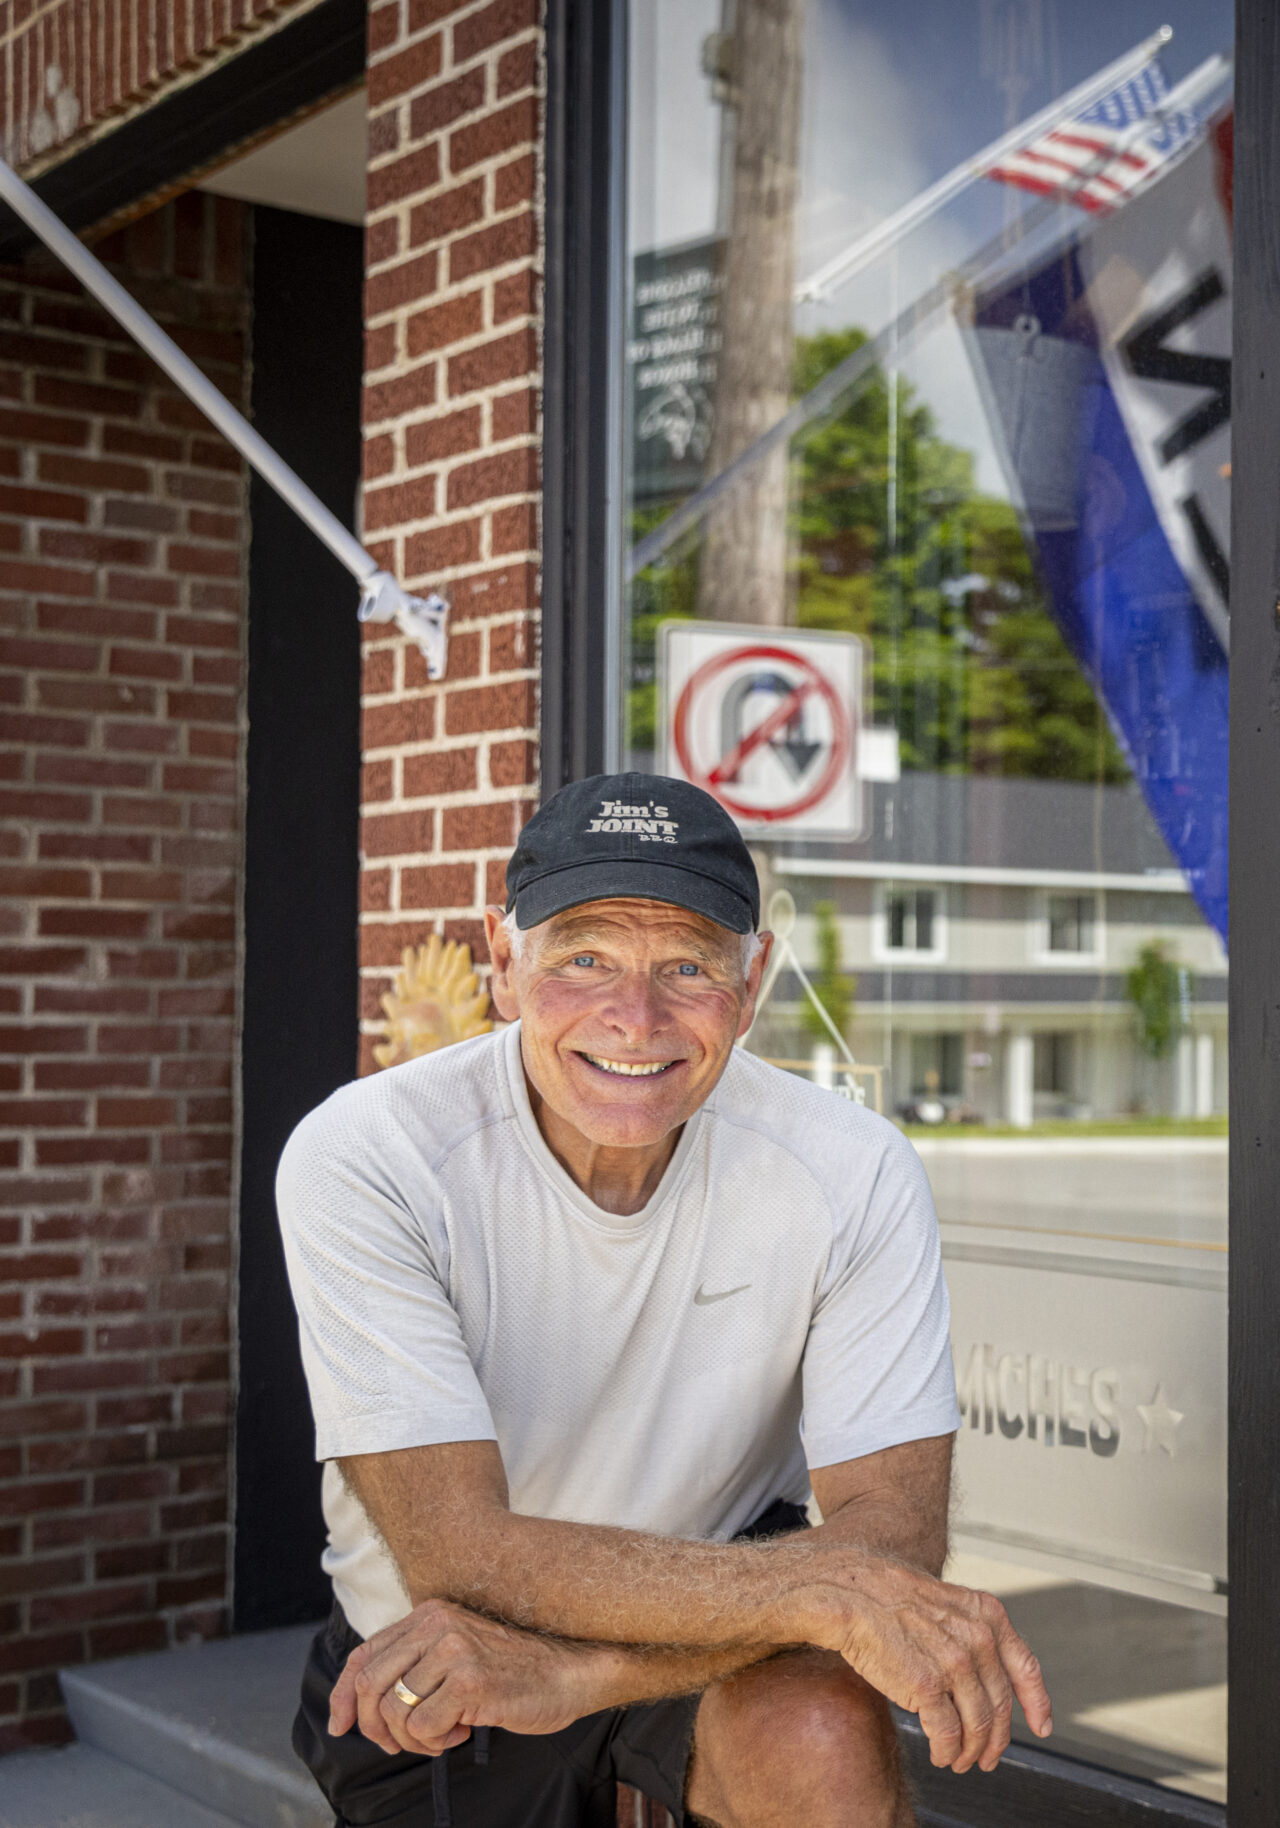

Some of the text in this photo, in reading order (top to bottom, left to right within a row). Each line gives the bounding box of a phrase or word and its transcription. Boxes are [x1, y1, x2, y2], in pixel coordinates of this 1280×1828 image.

[598, 800, 669, 818] Jim's
[584, 818, 679, 836] JOINT
[638, 833, 678, 844] BBQ
